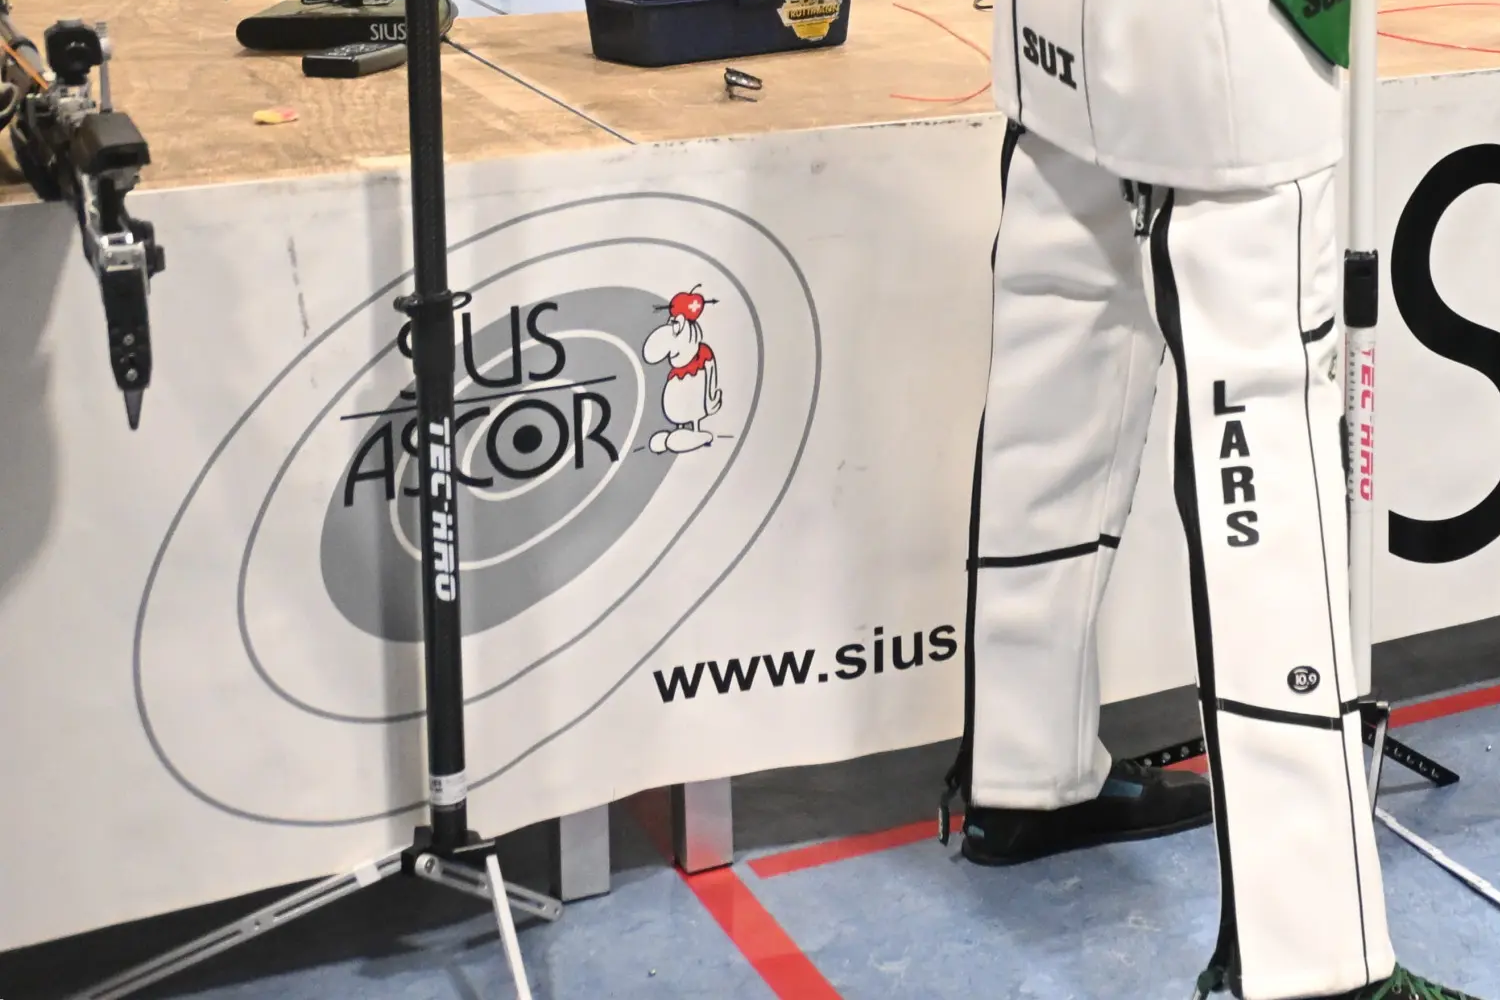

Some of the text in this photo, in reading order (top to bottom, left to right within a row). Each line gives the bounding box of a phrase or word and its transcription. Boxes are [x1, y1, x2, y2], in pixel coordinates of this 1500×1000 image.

[370, 22, 407, 42] SIUS
[1022, 26, 1078, 90] SUI
[1212, 379, 1260, 548] LARS
[427, 417, 457, 602] TEC-HRO
[653, 624, 958, 704] www.sius
[1294, 673, 1317, 687] 10.9
